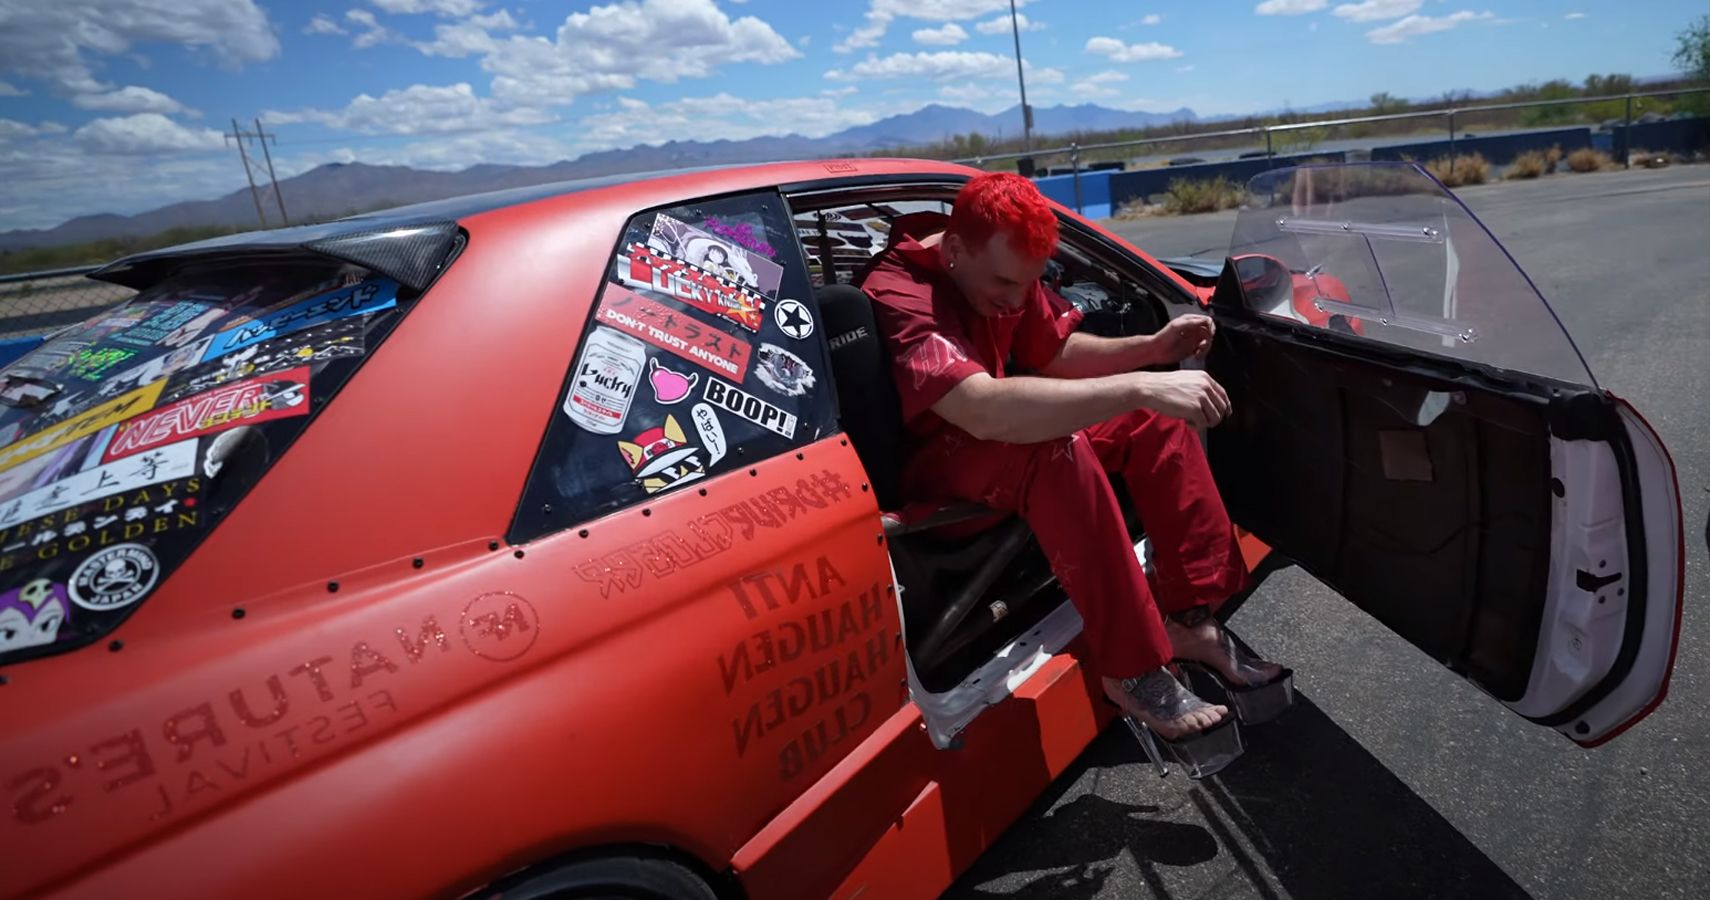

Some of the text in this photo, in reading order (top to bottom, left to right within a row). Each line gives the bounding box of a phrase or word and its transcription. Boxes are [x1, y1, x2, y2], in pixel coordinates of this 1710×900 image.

[617, 254, 714, 303] LUCKY
[606, 309, 646, 332] DON'T
[648, 325, 689, 351] TRUST
[689, 345, 739, 374] ANYONE
[829, 326, 869, 350] RIDE
[581, 362, 633, 398] Lucky
[110, 384, 263, 456] NEVER
[706, 380, 789, 434] BOOP!
[104, 478, 200, 512] DAYS
[37, 511, 198, 560] GOLDEN
[89, 583, 144, 605] JAPAN
